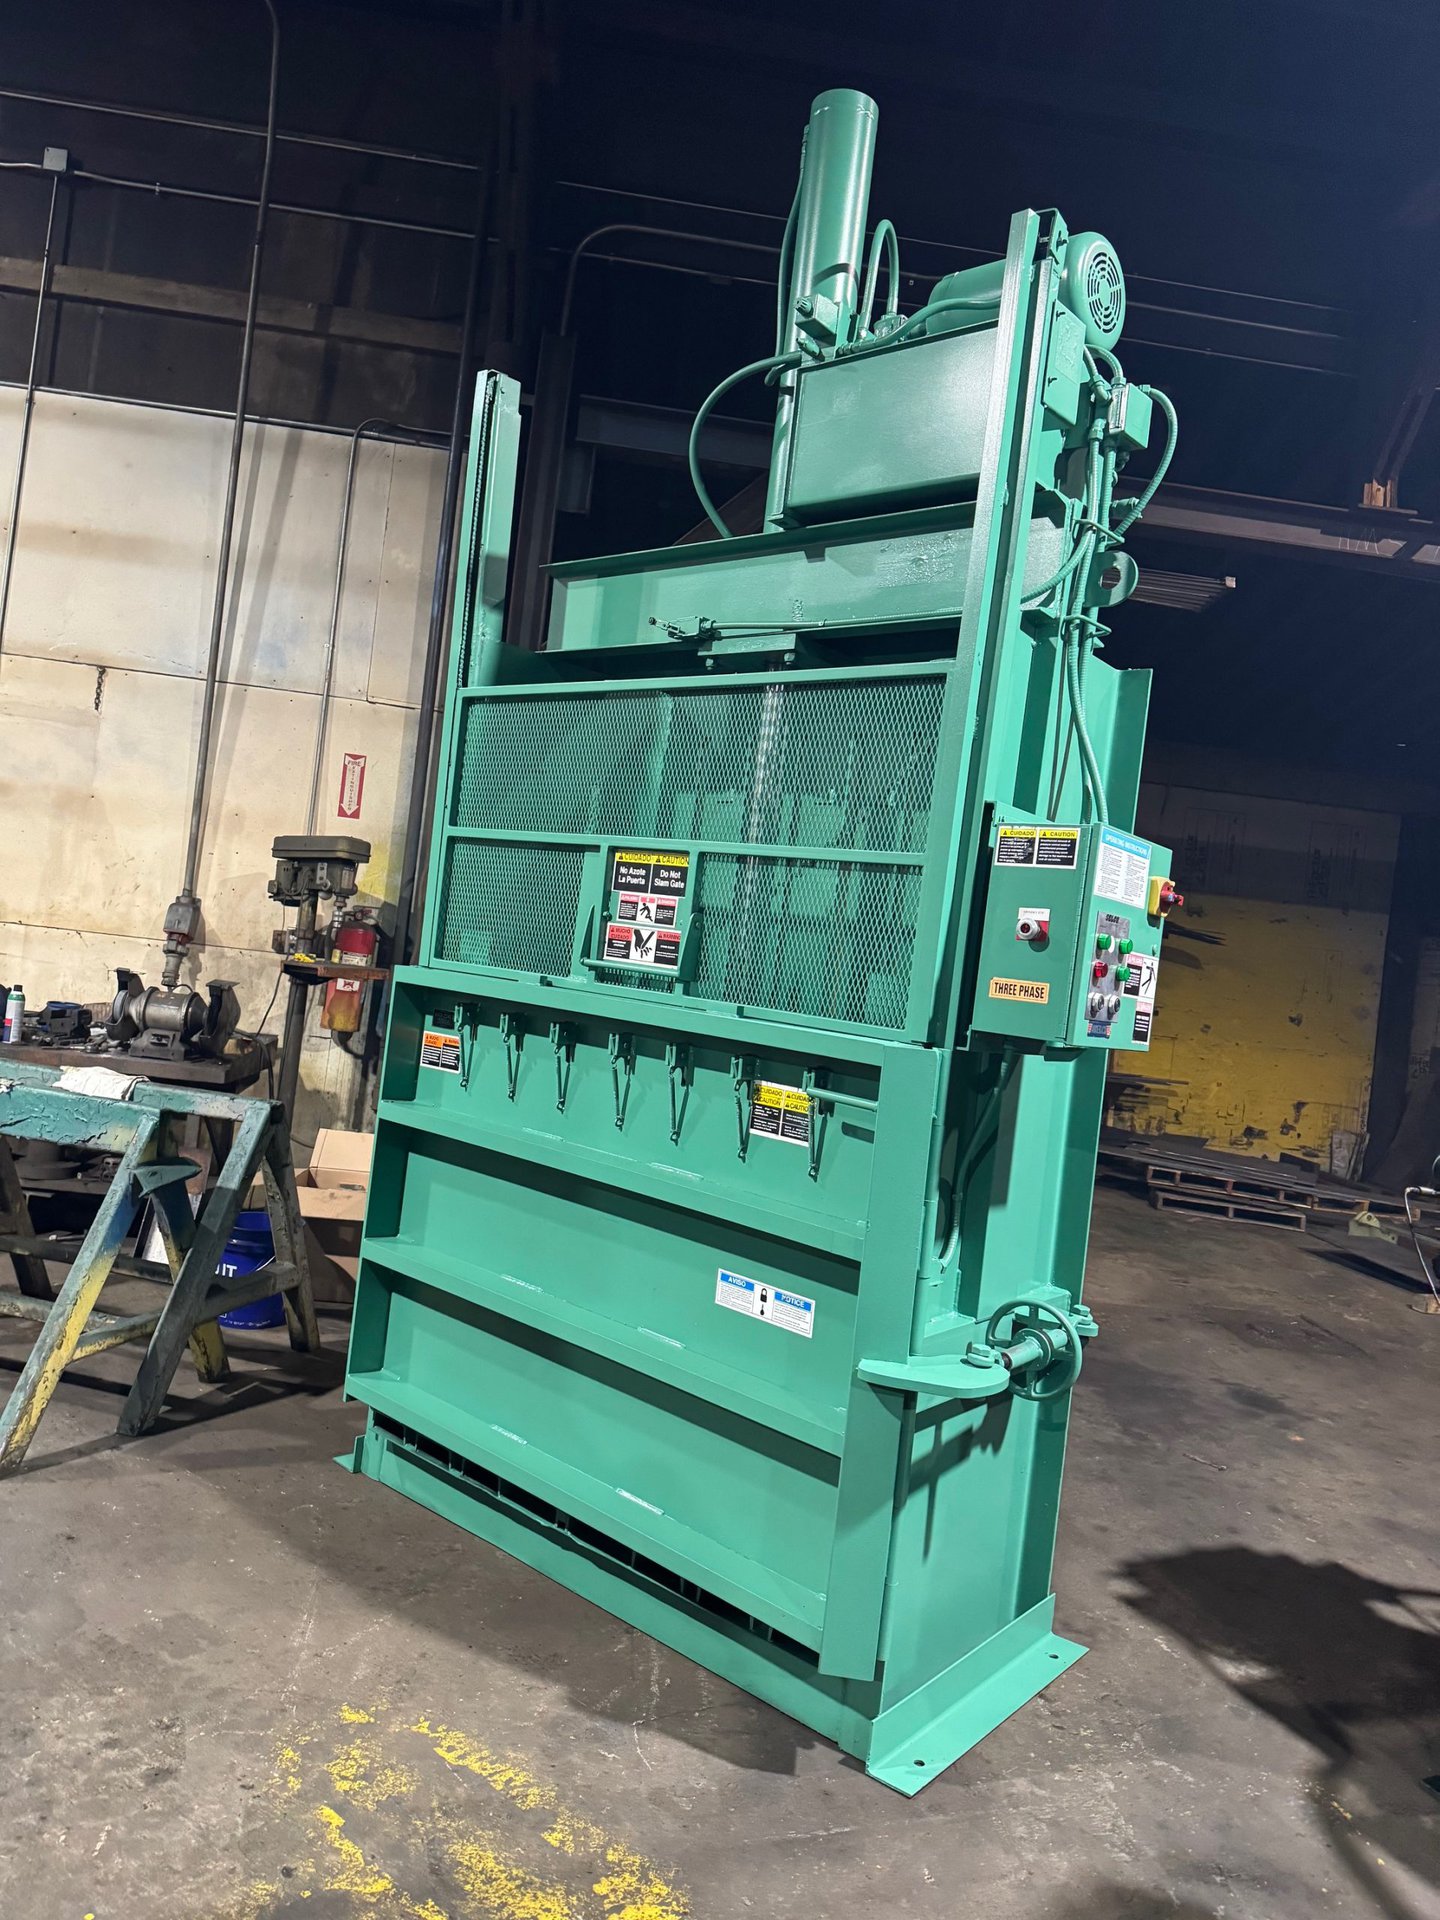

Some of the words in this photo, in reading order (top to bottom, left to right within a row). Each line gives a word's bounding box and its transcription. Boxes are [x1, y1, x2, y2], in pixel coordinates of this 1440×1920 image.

[624, 853, 652, 862] CUIDADO
[662, 855, 689, 866] CAUTION
[620, 866, 628, 874] No
[629, 867, 646, 876] Azote
[660, 869, 669, 878] Do
[670, 871, 681, 879] Not
[618, 875, 626, 883] La
[627, 875, 646, 885] Puerta
[654, 878, 670, 887] Slam
[670, 879, 685, 889] Gate
[994, 982, 1018, 996] THREE
[1018, 984, 1045, 999] PHASE
[761, 1087, 783, 1097] CUIDADO
[760, 1097, 781, 1107] CAUTION
[790, 1102, 809, 1112] CAUTIO
[728, 1275, 747, 1288] AVISO
[781, 1293, 806, 1308] NOTICE
